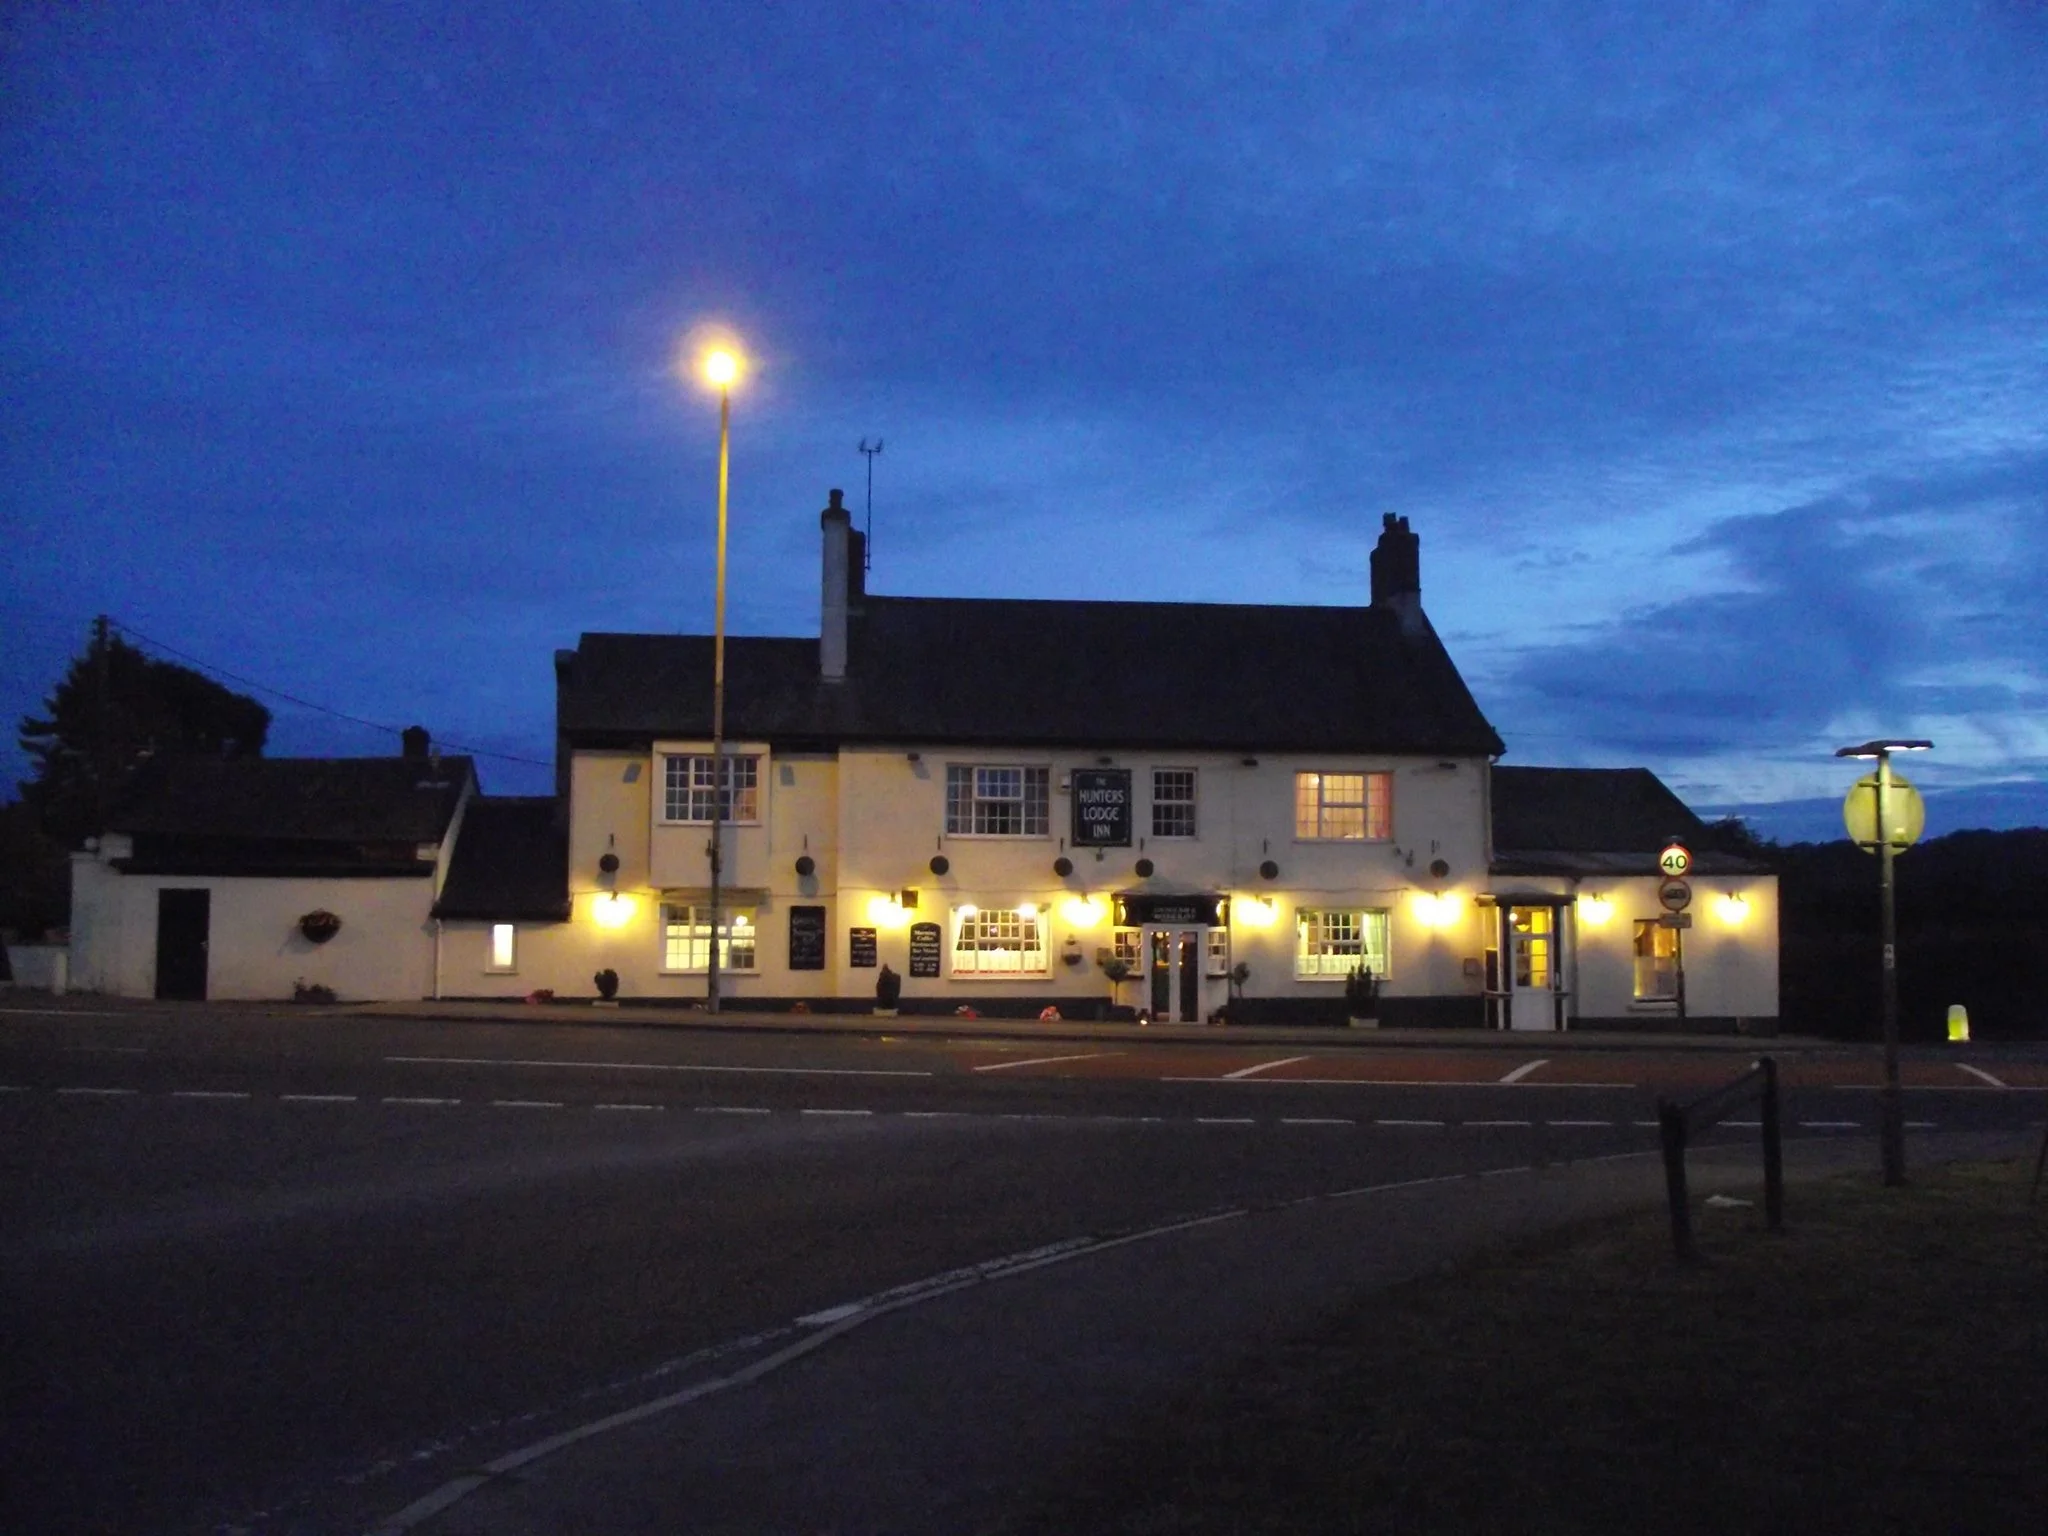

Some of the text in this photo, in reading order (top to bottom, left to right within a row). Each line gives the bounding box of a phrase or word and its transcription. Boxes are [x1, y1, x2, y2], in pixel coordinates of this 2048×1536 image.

[1079, 789, 1125, 804] HUNTERS
[1083, 806, 1120, 821] LODGE
[1092, 824, 1111, 838] INN
[1662, 855, 1687, 869] 40
